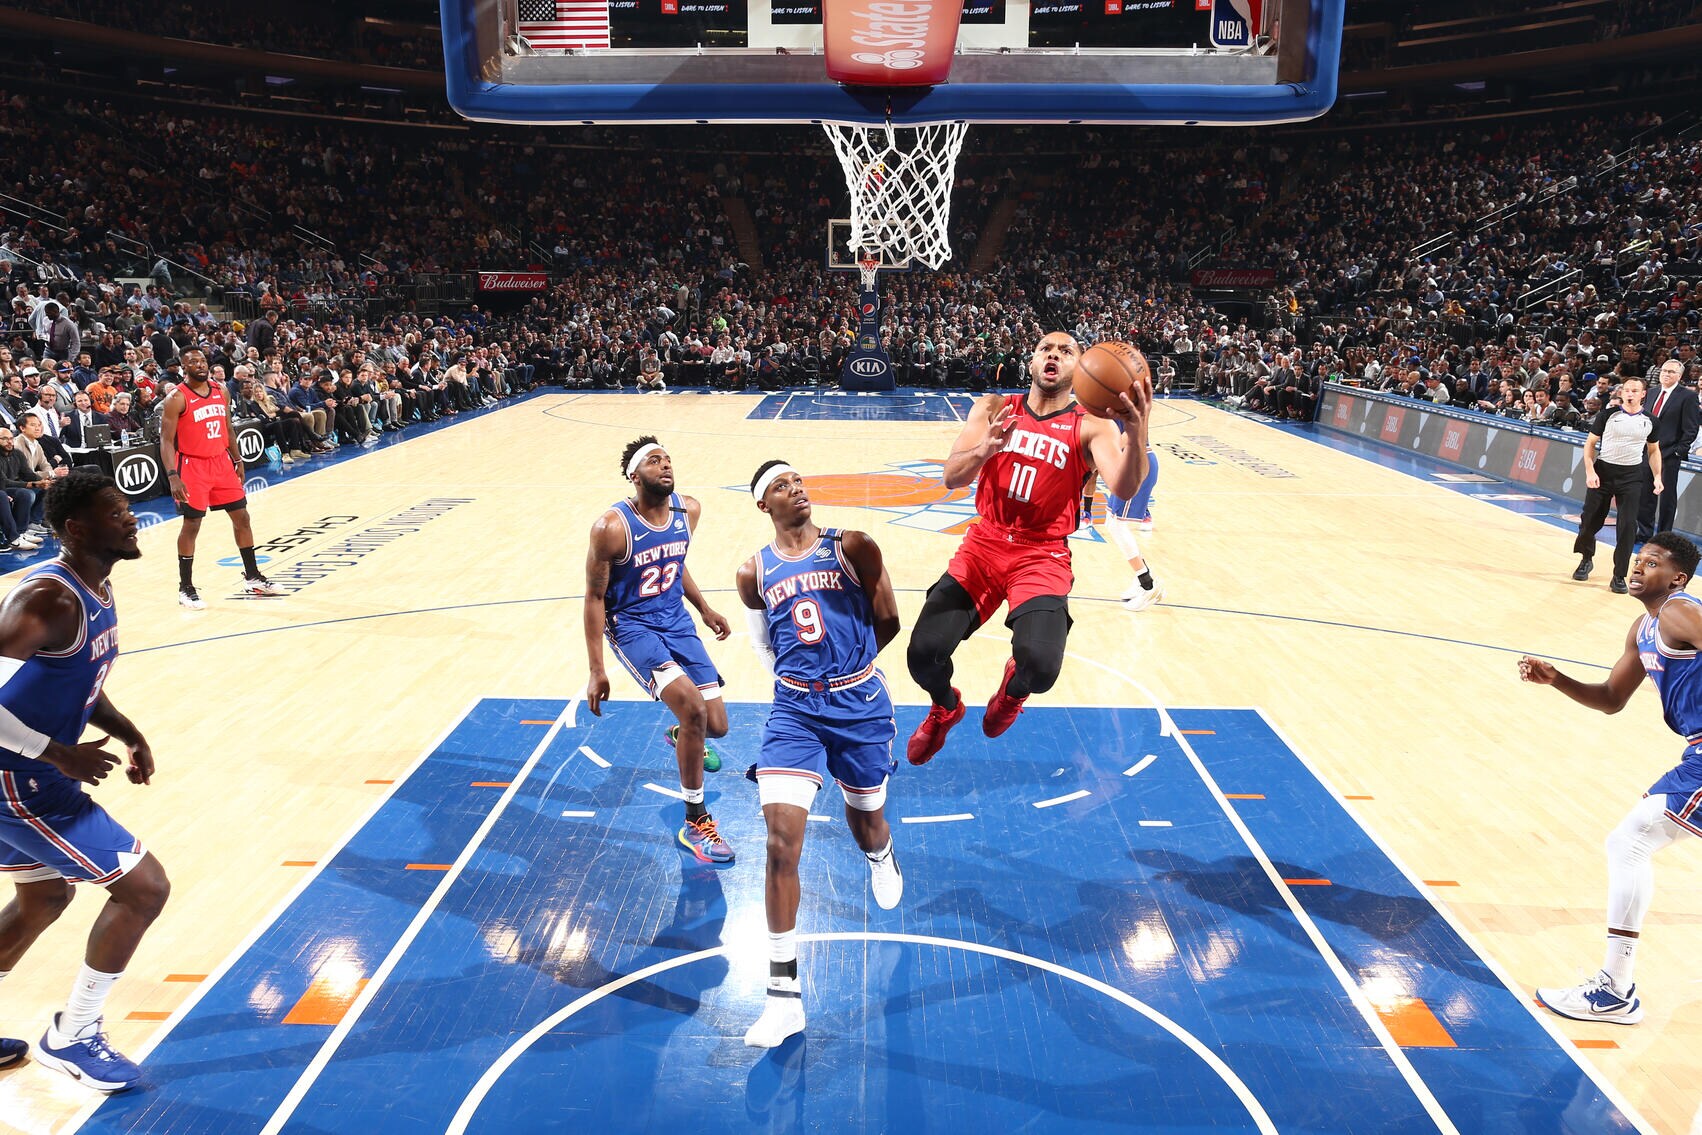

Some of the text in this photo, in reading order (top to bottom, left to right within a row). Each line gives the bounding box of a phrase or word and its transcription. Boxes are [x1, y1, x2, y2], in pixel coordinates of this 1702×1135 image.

[1218, 20, 1242, 40] NBA
[480, 274, 546, 289] Budweiser
[1197, 270, 1269, 286] Budweiser
[856, 361, 881, 373] KIA
[193, 404, 226, 422] ROCKETS
[206, 420, 221, 439] 32
[1445, 430, 1459, 450] JBL
[239, 434, 261, 452] KIA
[999, 429, 1070, 469] OCKETS
[1518, 448, 1537, 471] JBL
[122, 462, 152, 489] KIA
[1008, 462, 1037, 503] 10
[251, 514, 359, 553] CHASE
[634, 540, 687, 568] NEW YORK
[639, 565, 680, 597] 23
[765, 571, 843, 609] NEW YORK
[791, 598, 826, 645] 9
[91, 631, 109, 660] NEW
